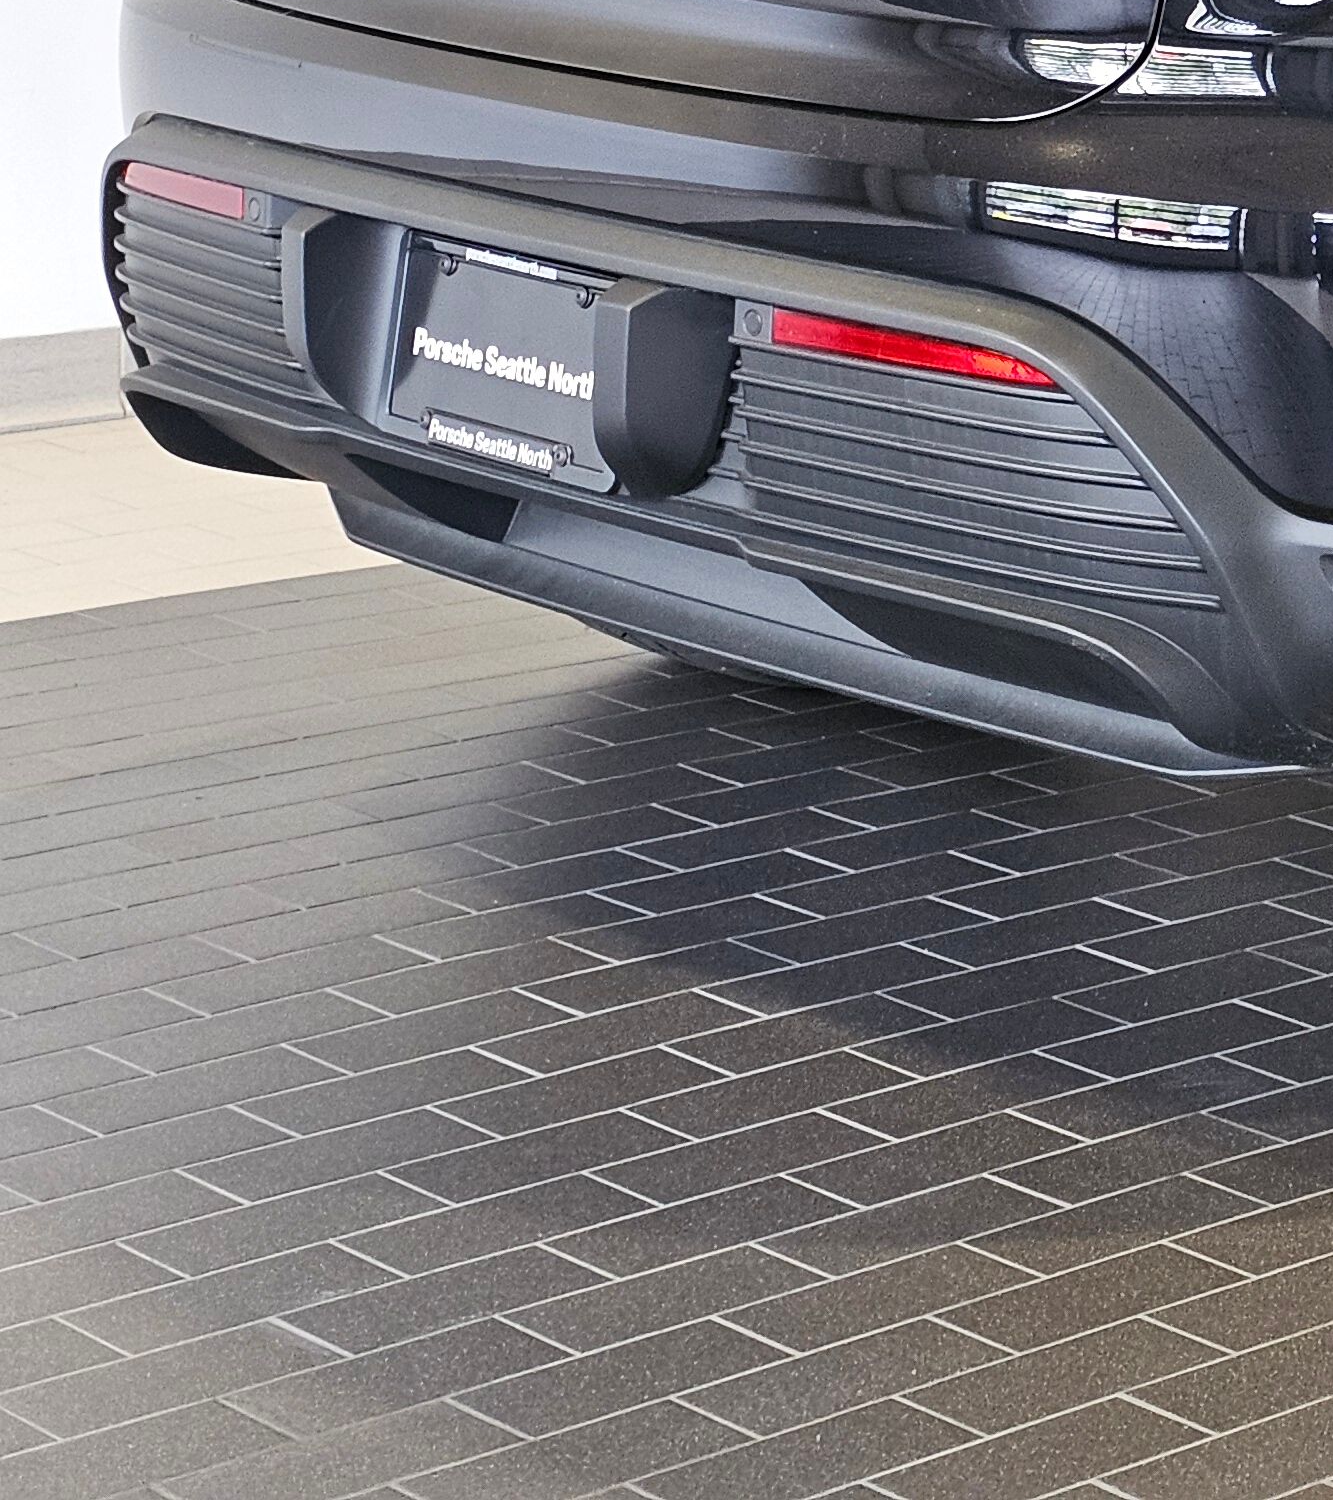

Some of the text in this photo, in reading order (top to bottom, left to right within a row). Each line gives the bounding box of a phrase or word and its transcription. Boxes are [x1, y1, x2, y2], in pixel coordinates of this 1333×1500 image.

[412, 326, 484, 372] Porsche
[485, 345, 546, 389] Seattle
[428, 418, 553, 470] Porsche Seattle North
